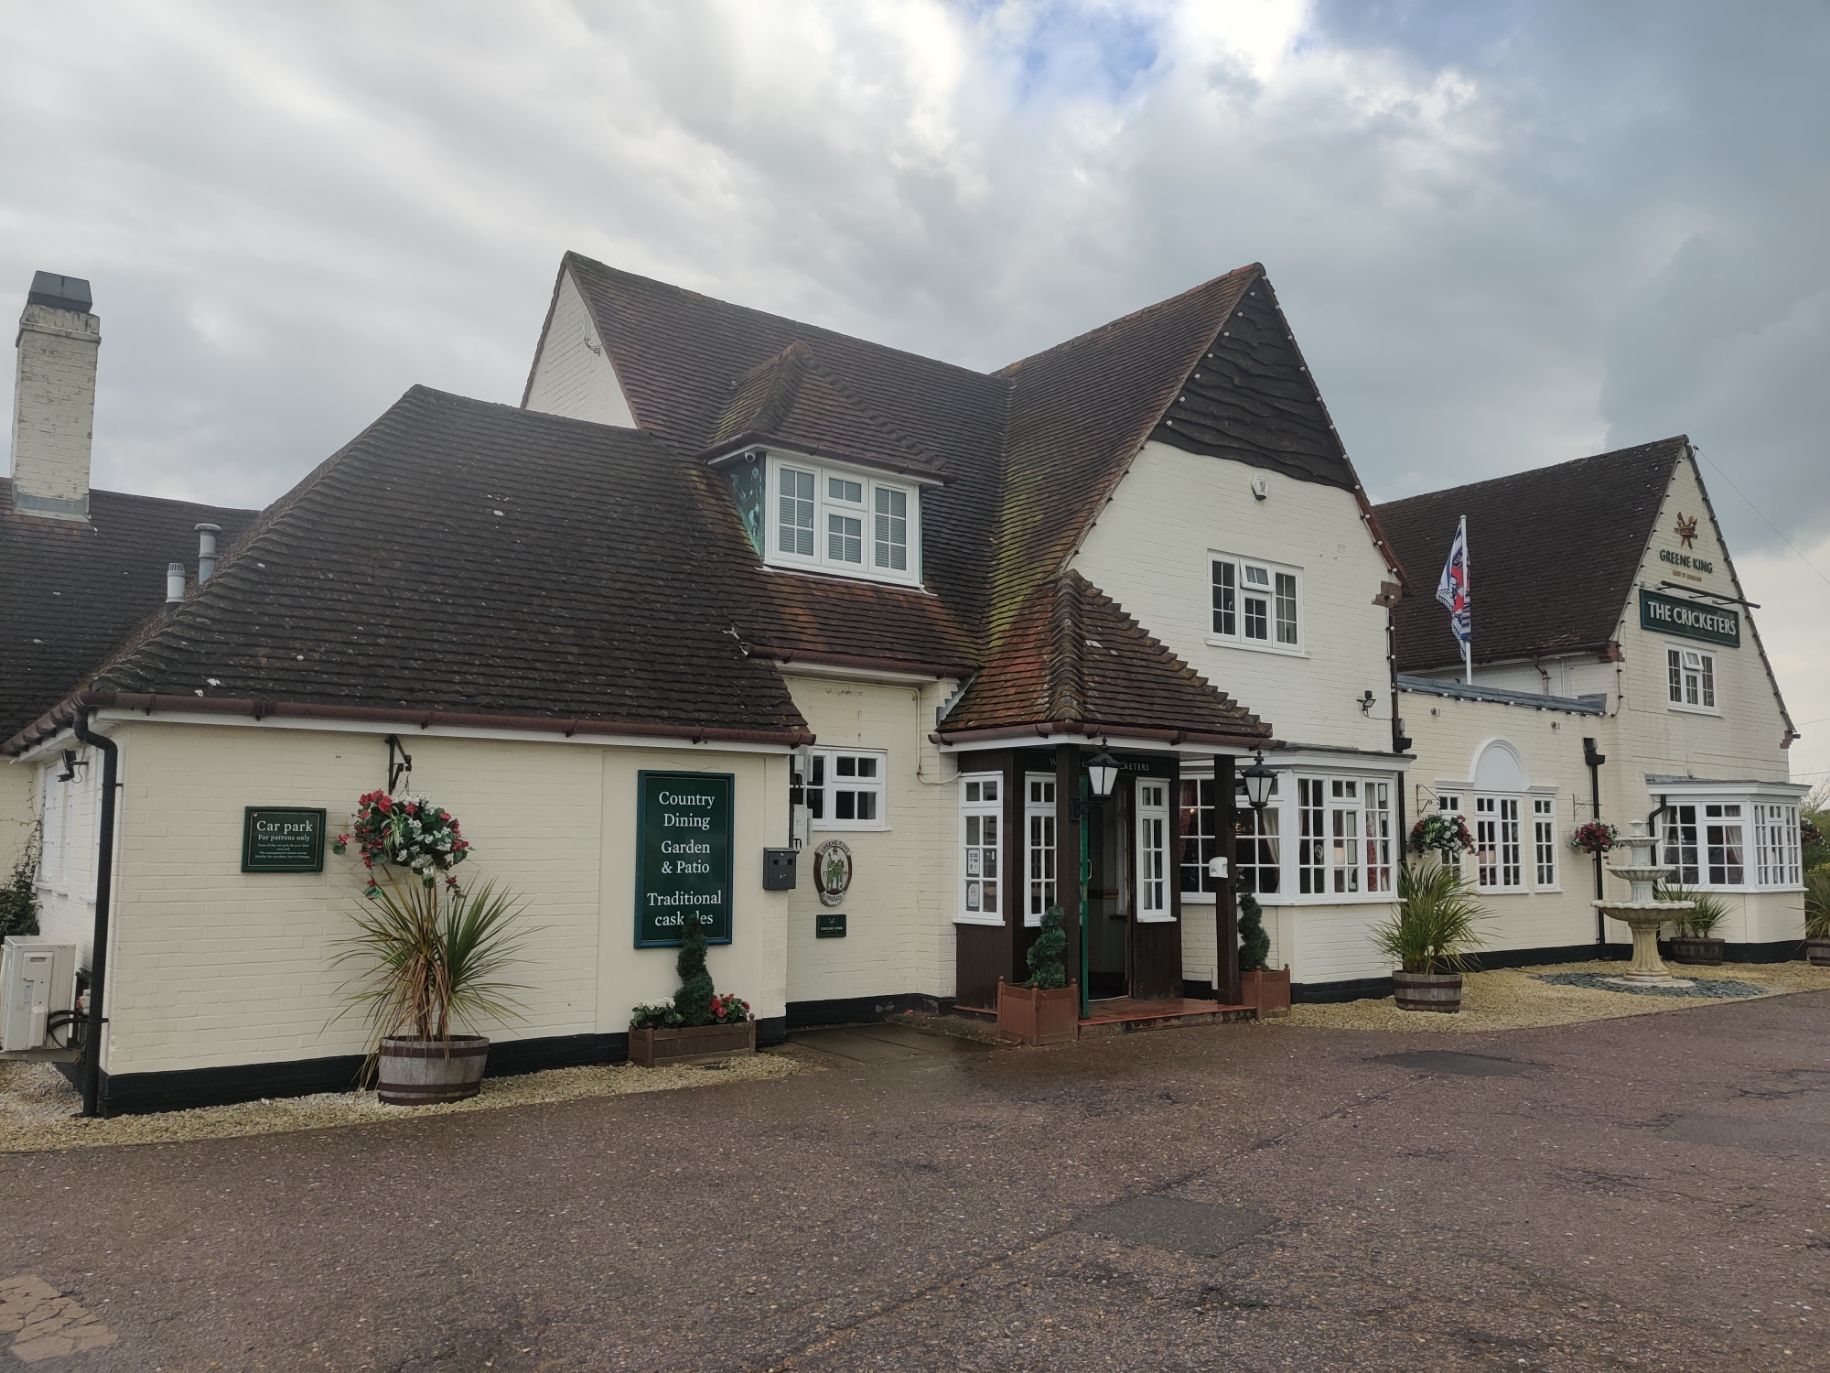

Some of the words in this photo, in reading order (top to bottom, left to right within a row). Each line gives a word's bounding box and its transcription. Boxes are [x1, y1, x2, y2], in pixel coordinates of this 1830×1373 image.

[1659, 549, 1691, 569] GREENE
[1692, 558, 1713, 574] KING
[1647, 601, 1672, 622] THE
[1673, 607, 1737, 636] CRICKETERS
[658, 791, 716, 809] Country
[256, 820, 280, 832] Car
[283, 819, 313, 835] park
[663, 812, 711, 831] Dining
[270, 834, 295, 842] patrons
[296, 834, 310, 842] only
[661, 839, 711, 854] Garden
[661, 860, 673, 874] &
[676, 859, 710, 874] Patio
[646, 889, 722, 906] Traditional
[654, 910, 685, 927] cask
